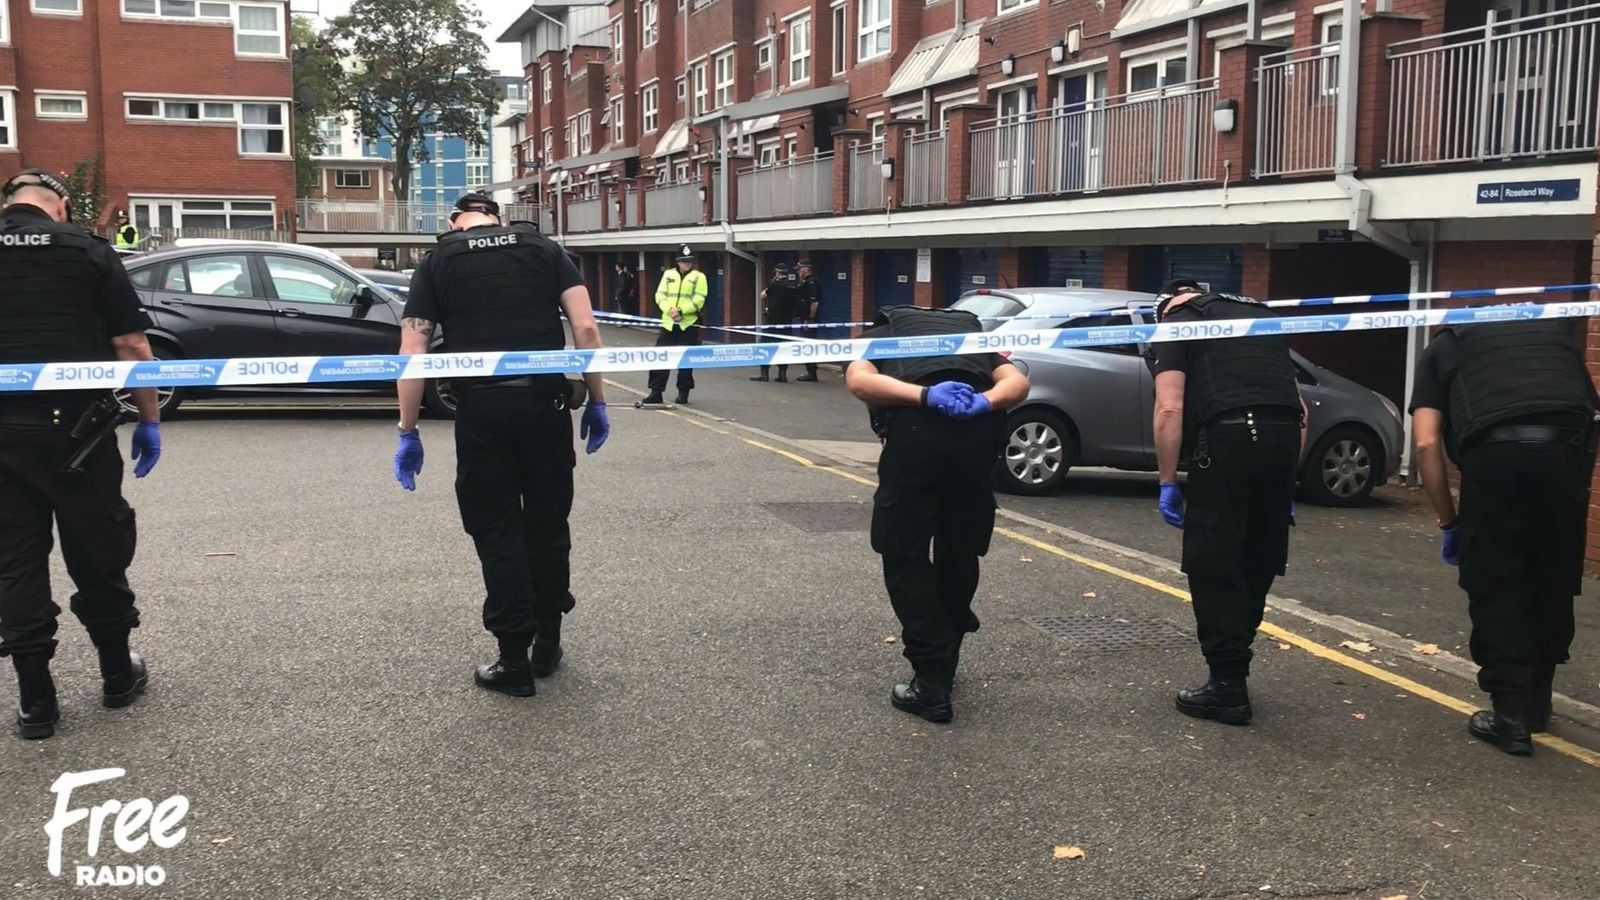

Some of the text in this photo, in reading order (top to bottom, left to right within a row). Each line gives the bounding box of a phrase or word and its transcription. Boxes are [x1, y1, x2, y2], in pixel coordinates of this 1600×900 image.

[1480, 187, 1555, 198] 42-84 Roseland Way
[0, 234, 51, 246] OLICE
[468, 234, 518, 249] POLICE
[1558, 304, 1600, 317] LICE
[1363, 314, 1428, 328] POLICE
[1170, 324, 1233, 339] POLICE
[978, 333, 1041, 348] POLICE
[791, 342, 853, 356] POLICE
[423, 356, 484, 370] POLICE
[608, 350, 669, 364] POLICE
[55, 366, 116, 381] POLICE
[238, 361, 299, 376] POLICE
